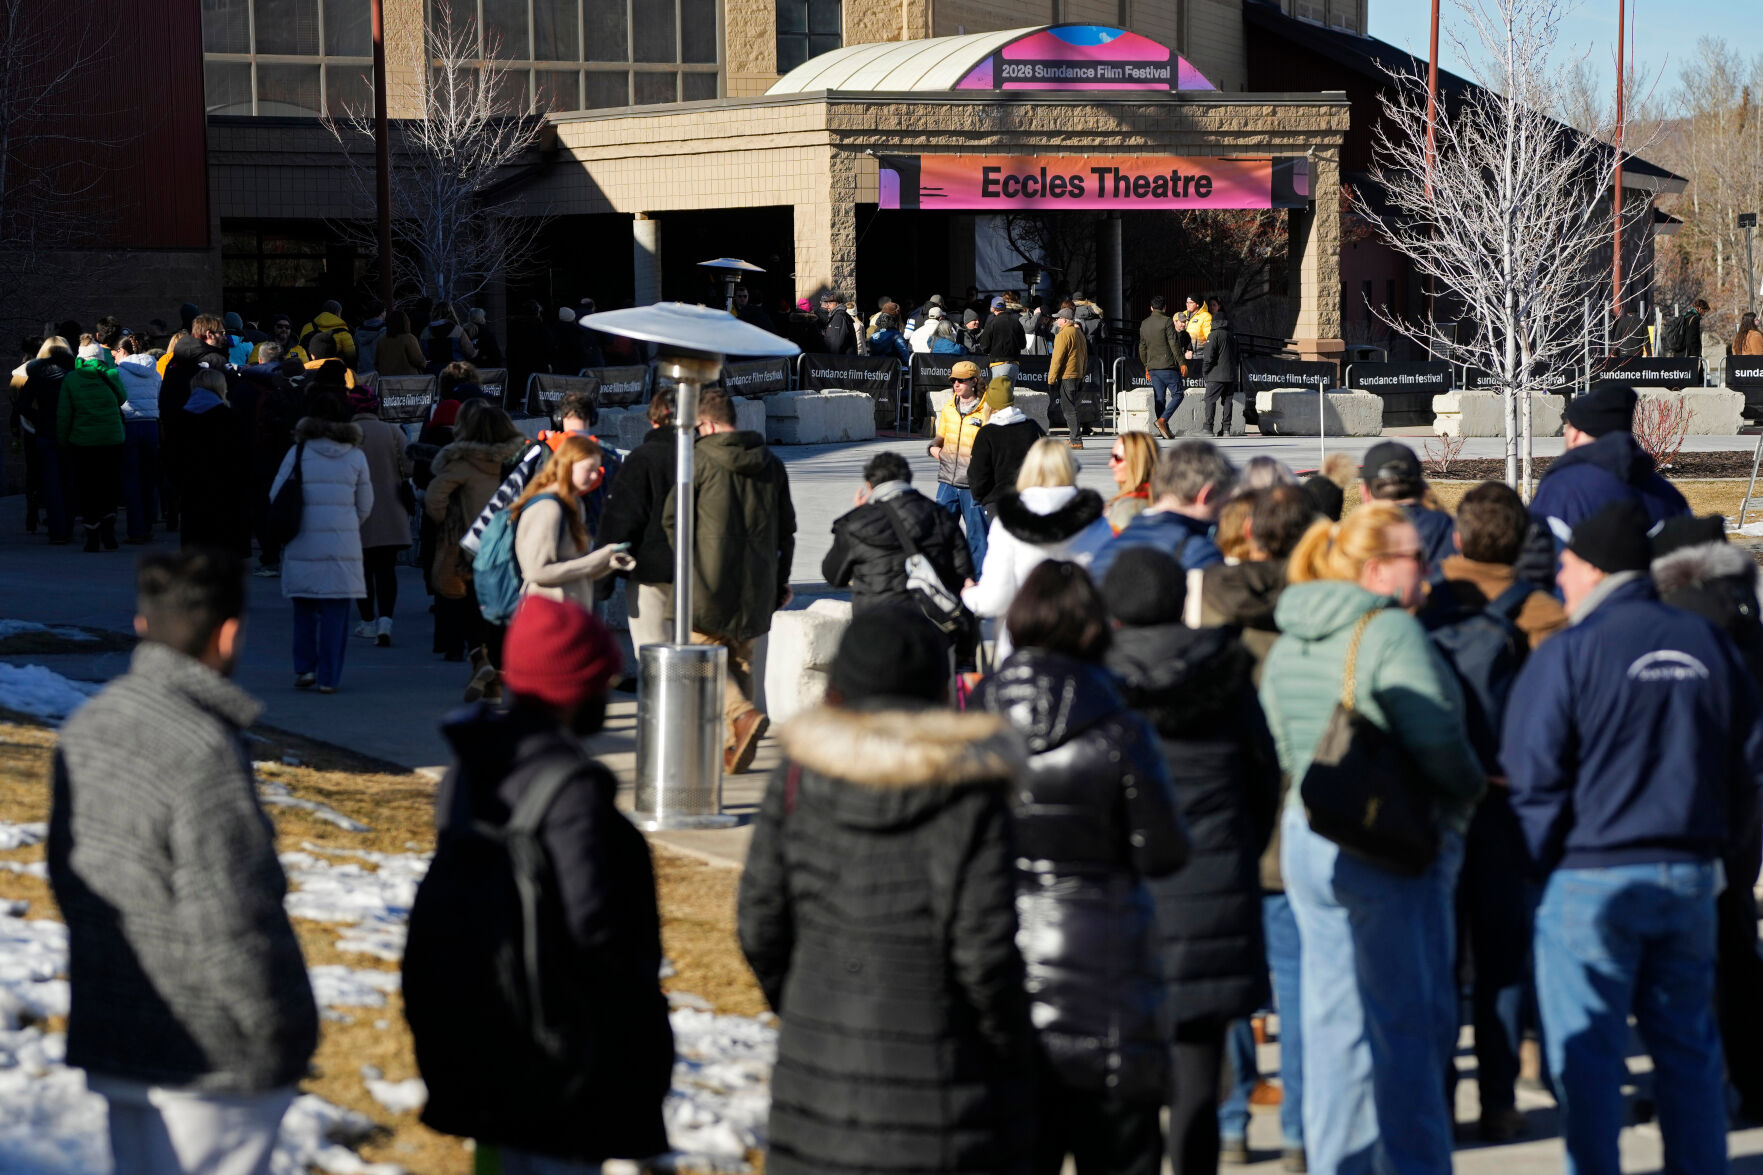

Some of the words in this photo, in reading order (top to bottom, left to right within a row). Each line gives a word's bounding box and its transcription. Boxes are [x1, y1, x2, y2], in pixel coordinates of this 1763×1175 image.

[1002, 64, 1032, 78] 2026
[1034, 64, 1095, 79] Sundance
[1097, 65, 1123, 79] Film
[1125, 65, 1171, 79] Festival
[981, 166, 1085, 199] Eccles
[1090, 166, 1213, 199] Theatre
[811, 369, 848, 379] sundance
[848, 369, 863, 380] film
[864, 370, 891, 381] festival
[920, 366, 951, 376] sundance
[1017, 371, 1043, 382] dance
[1600, 371, 1640, 380] sundance
[1641, 370, 1659, 380] film
[1660, 370, 1691, 380] festival
[1735, 368, 1763, 378] sunda
[726, 375, 752, 386] sundance
[752, 371, 764, 383] film
[764, 369, 783, 382] festival
[1248, 373, 1285, 383] sundance
[1286, 373, 1302, 384] film
[1302, 374, 1330, 385] festival
[1359, 376, 1398, 386] sundance
[1398, 374, 1414, 384] film
[1414, 373, 1443, 383] festival
